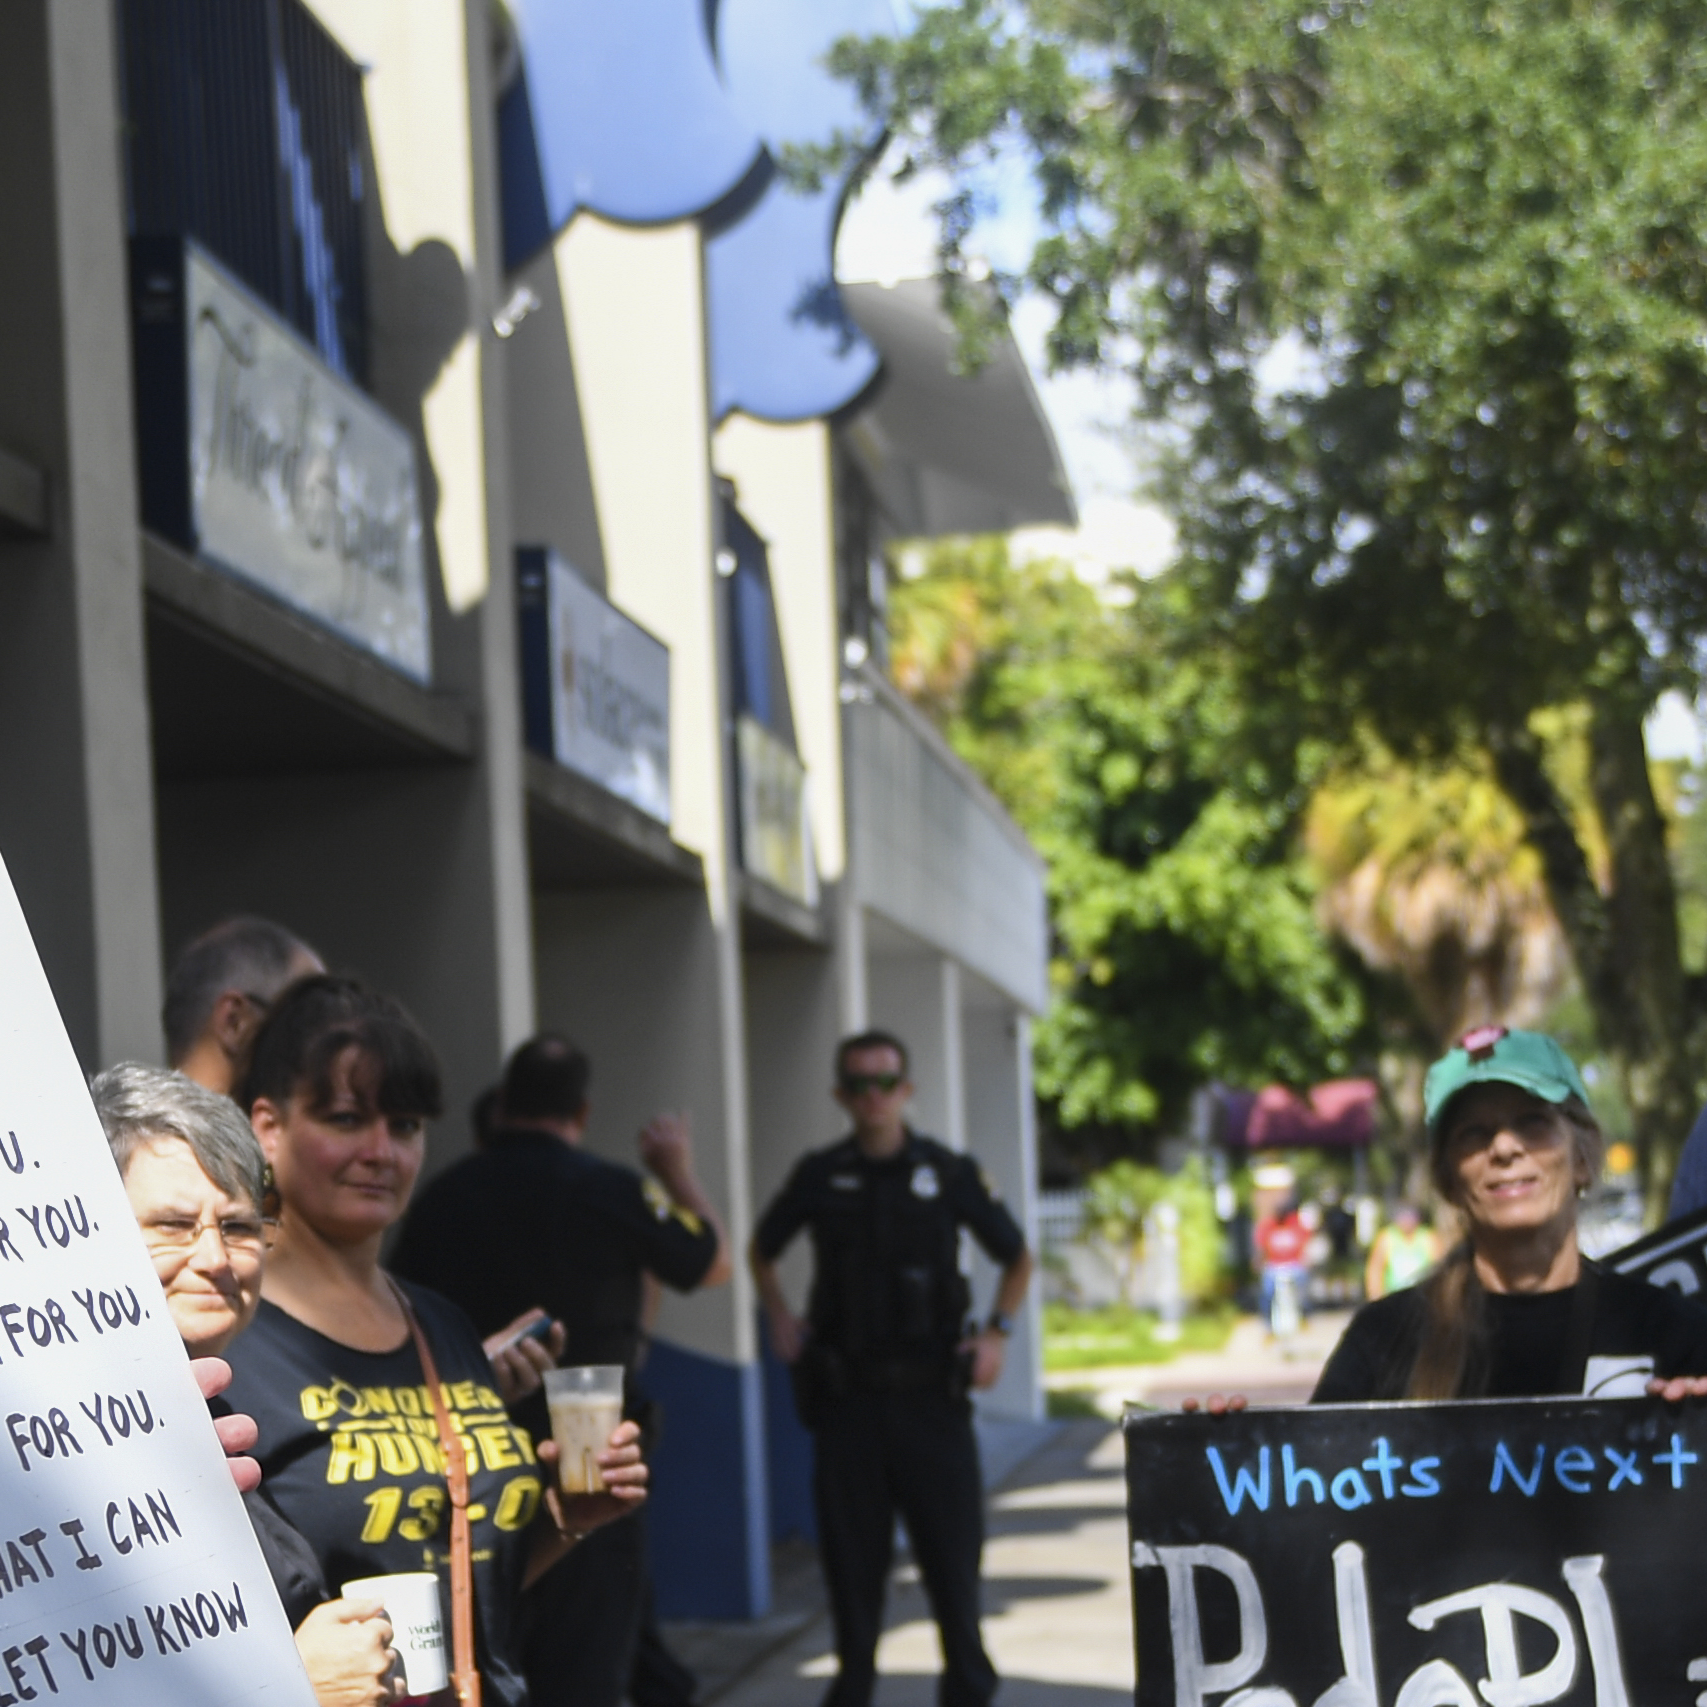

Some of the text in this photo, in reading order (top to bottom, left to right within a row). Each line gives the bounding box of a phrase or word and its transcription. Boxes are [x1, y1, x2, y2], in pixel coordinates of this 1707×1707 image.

[18, 1195, 101, 1250] YOU.
[0, 1297, 79, 1358] FOR
[73, 1285, 151, 1340] YOU.
[10, 1402, 84, 1471] FOR
[80, 1389, 166, 1444] YOU.
[1206, 1438, 1441, 1515] Whats
[1490, 1433, 1698, 1497] Next
[59, 1517, 103, 1573] I
[106, 1488, 183, 1558] CAN
[59, 1616, 145, 1682] YOU
[143, 1582, 250, 1658] KNOW
